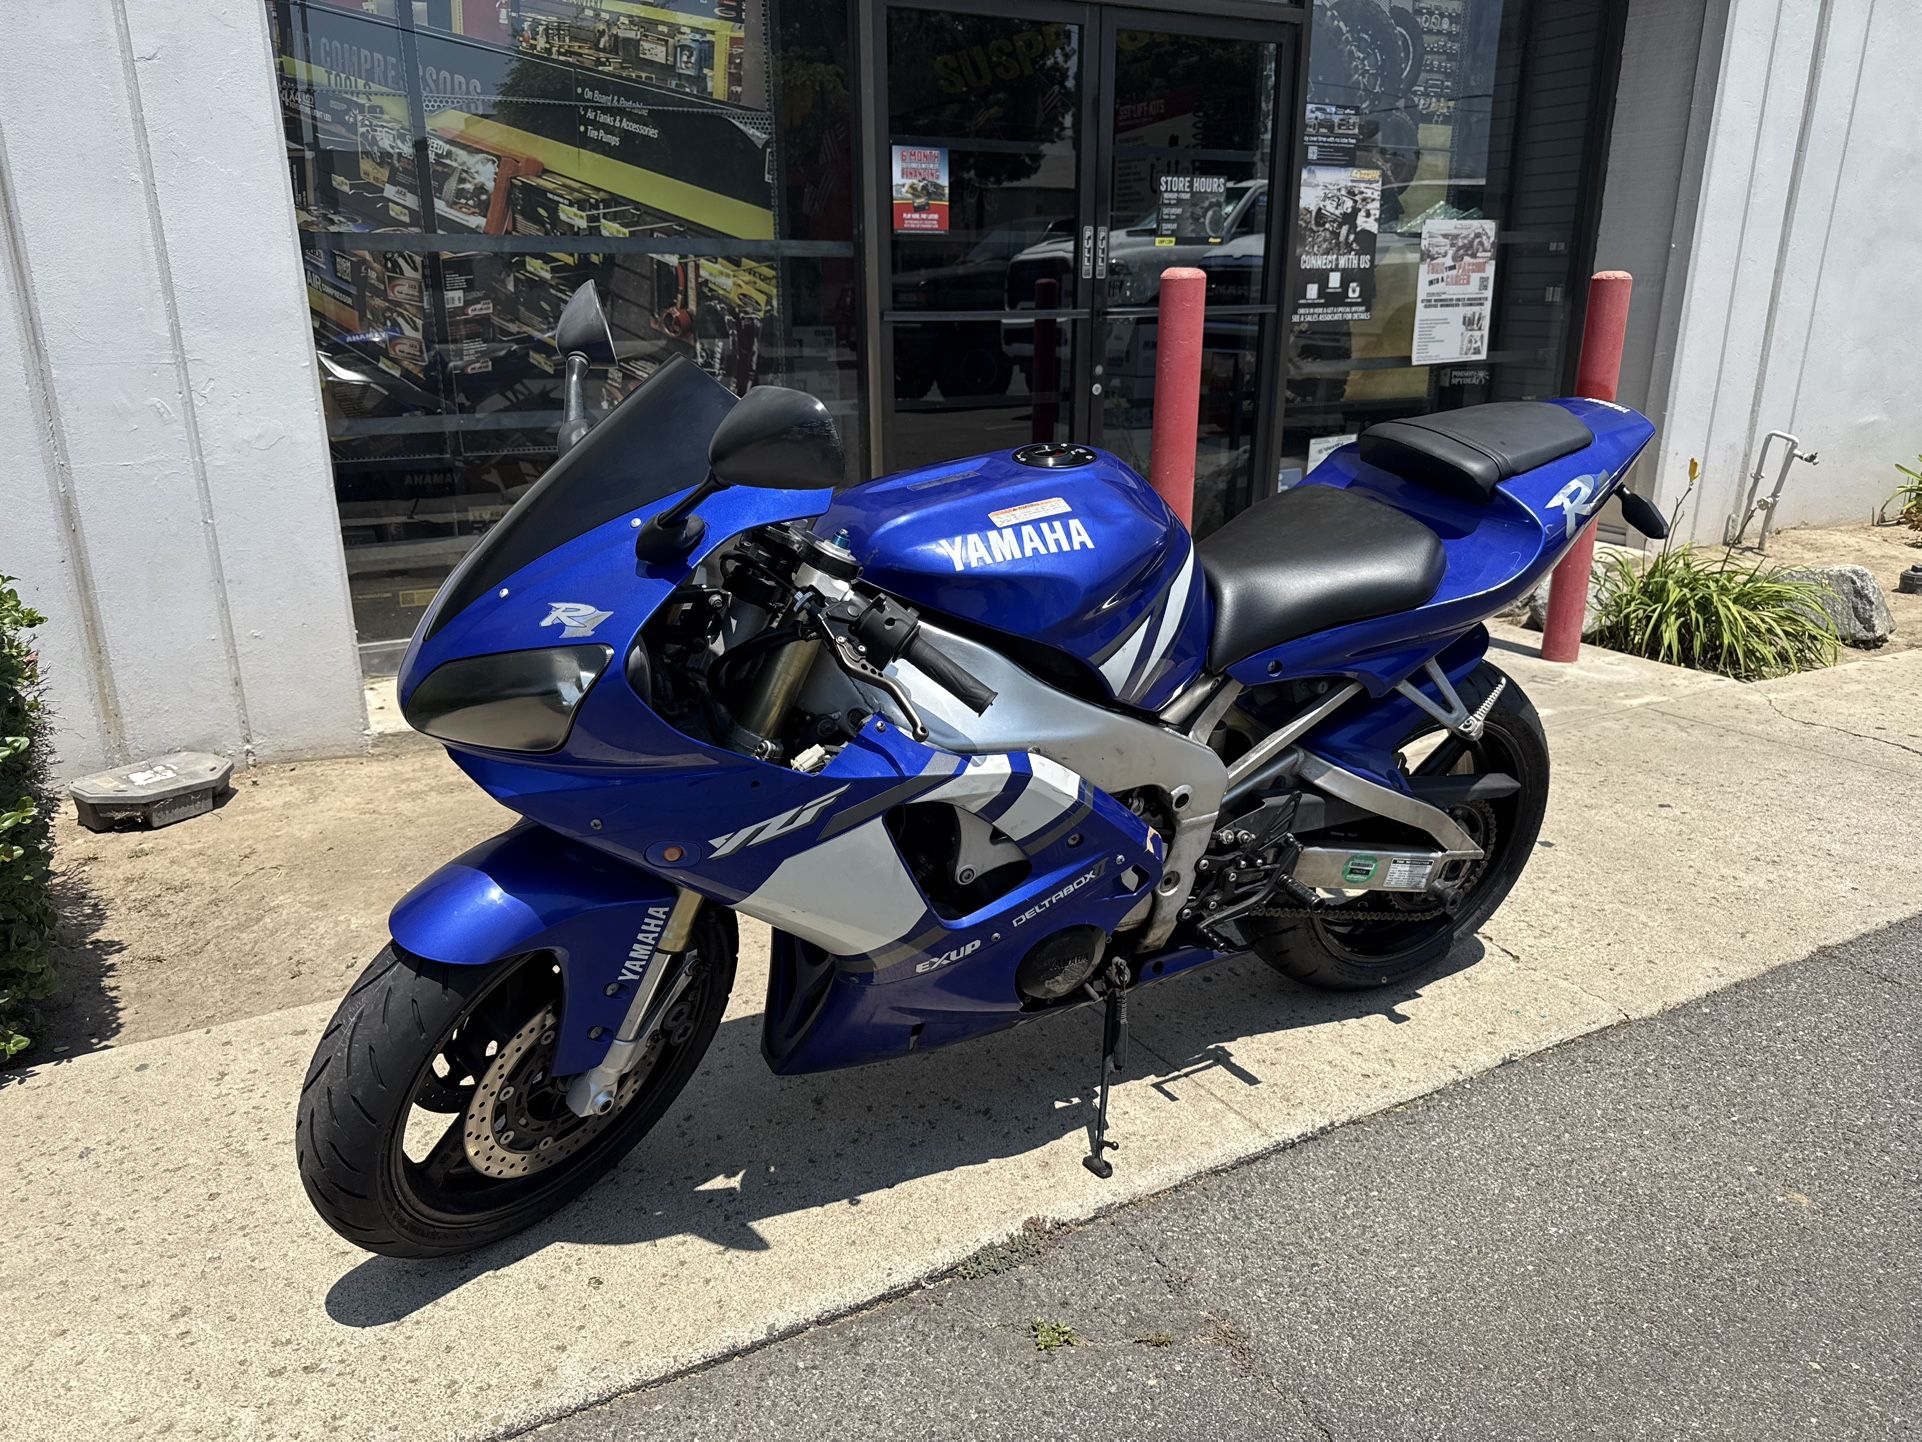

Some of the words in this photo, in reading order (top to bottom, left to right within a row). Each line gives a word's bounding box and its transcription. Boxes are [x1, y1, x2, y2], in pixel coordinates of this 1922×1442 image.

[583, 87, 594, 100] On
[593, 89, 613, 106] Board
[586, 108, 596, 120] Air
[596, 110, 615, 125] Tanks
[614, 116, 621, 127] &
[620, 117, 659, 139] Accessories
[586, 126, 599, 140] Tire
[598, 130, 621, 147] Pumps
[901, 150, 907, 162] 6
[909, 150, 940, 163] MONTH
[1160, 176, 1191, 192] STORE
[1192, 177, 1225, 193] HOURS
[1300, 255, 1337, 269] CONNECT
[1338, 254, 1358, 269] WITH
[1360, 255, 1371, 269] US
[306, 271, 323, 293] AIR
[1304, 313, 1318, 321] SALES
[1319, 313, 1343, 321] ASSOCIATE
[1352, 312, 1370, 320] DETAILS
[939, 518, 1095, 572] YAMAHA
[707, 782, 852, 860] YZF
[1013, 869, 1097, 927] DELTABOX
[617, 904, 670, 982] YAMAHA
[915, 939, 982, 974] EXUP
[1048, 952, 1089, 972] YAMAHA
